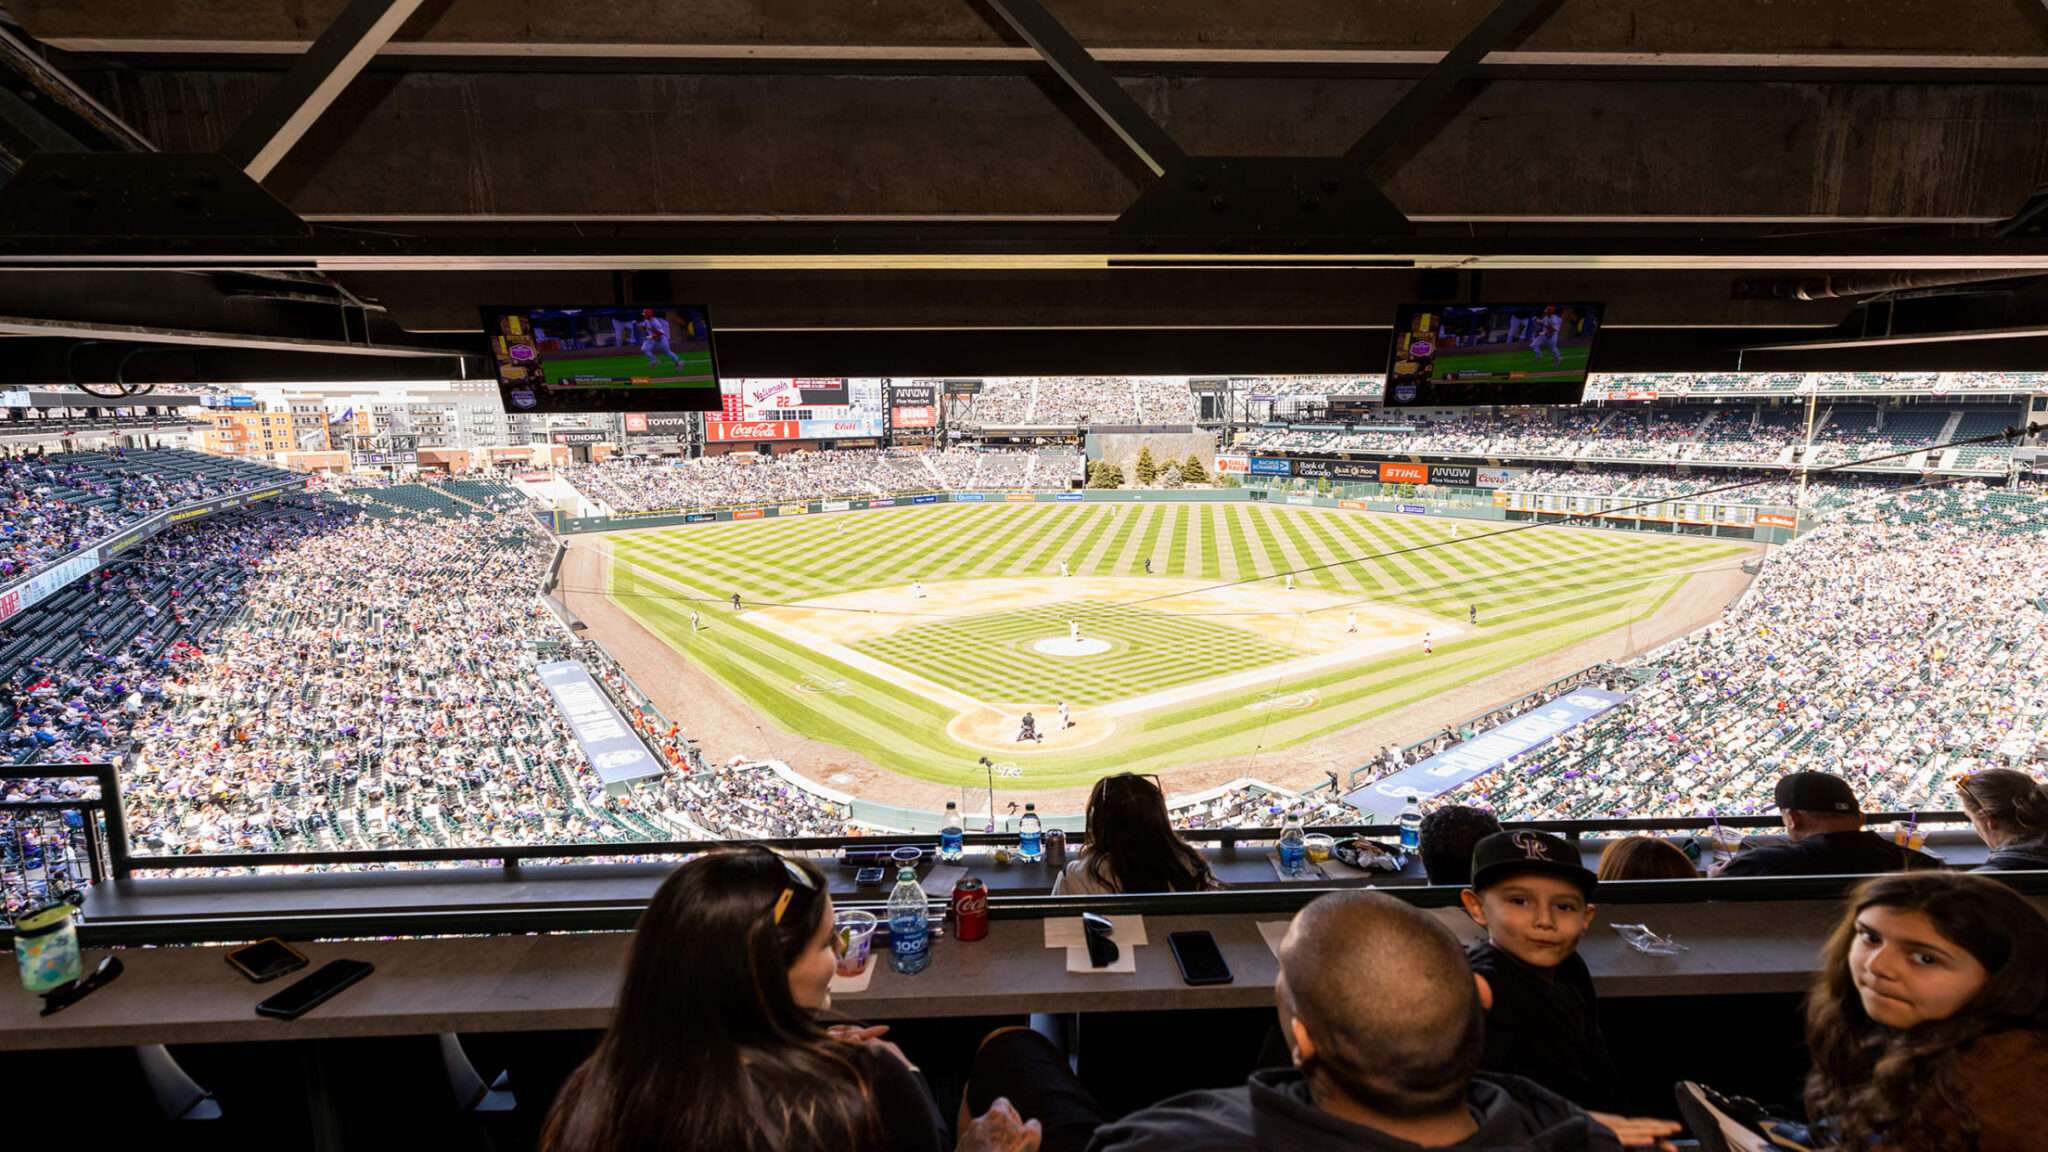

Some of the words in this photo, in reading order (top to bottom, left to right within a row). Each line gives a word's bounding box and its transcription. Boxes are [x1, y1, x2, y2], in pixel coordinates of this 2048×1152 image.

[753, 382, 789, 402] Nationals
[896, 388, 930, 398] ARROW
[777, 396, 790, 408] 22
[647, 418, 685, 426] TOYOTA
[730, 423, 776, 438] Coca-Cola
[1300, 461, 1317, 470] Bank
[1317, 462, 1326, 470] of
[1300, 469, 1331, 477] Colorado
[1385, 468, 1422, 478] STIHL
[1432, 467, 1471, 477] ARROW
